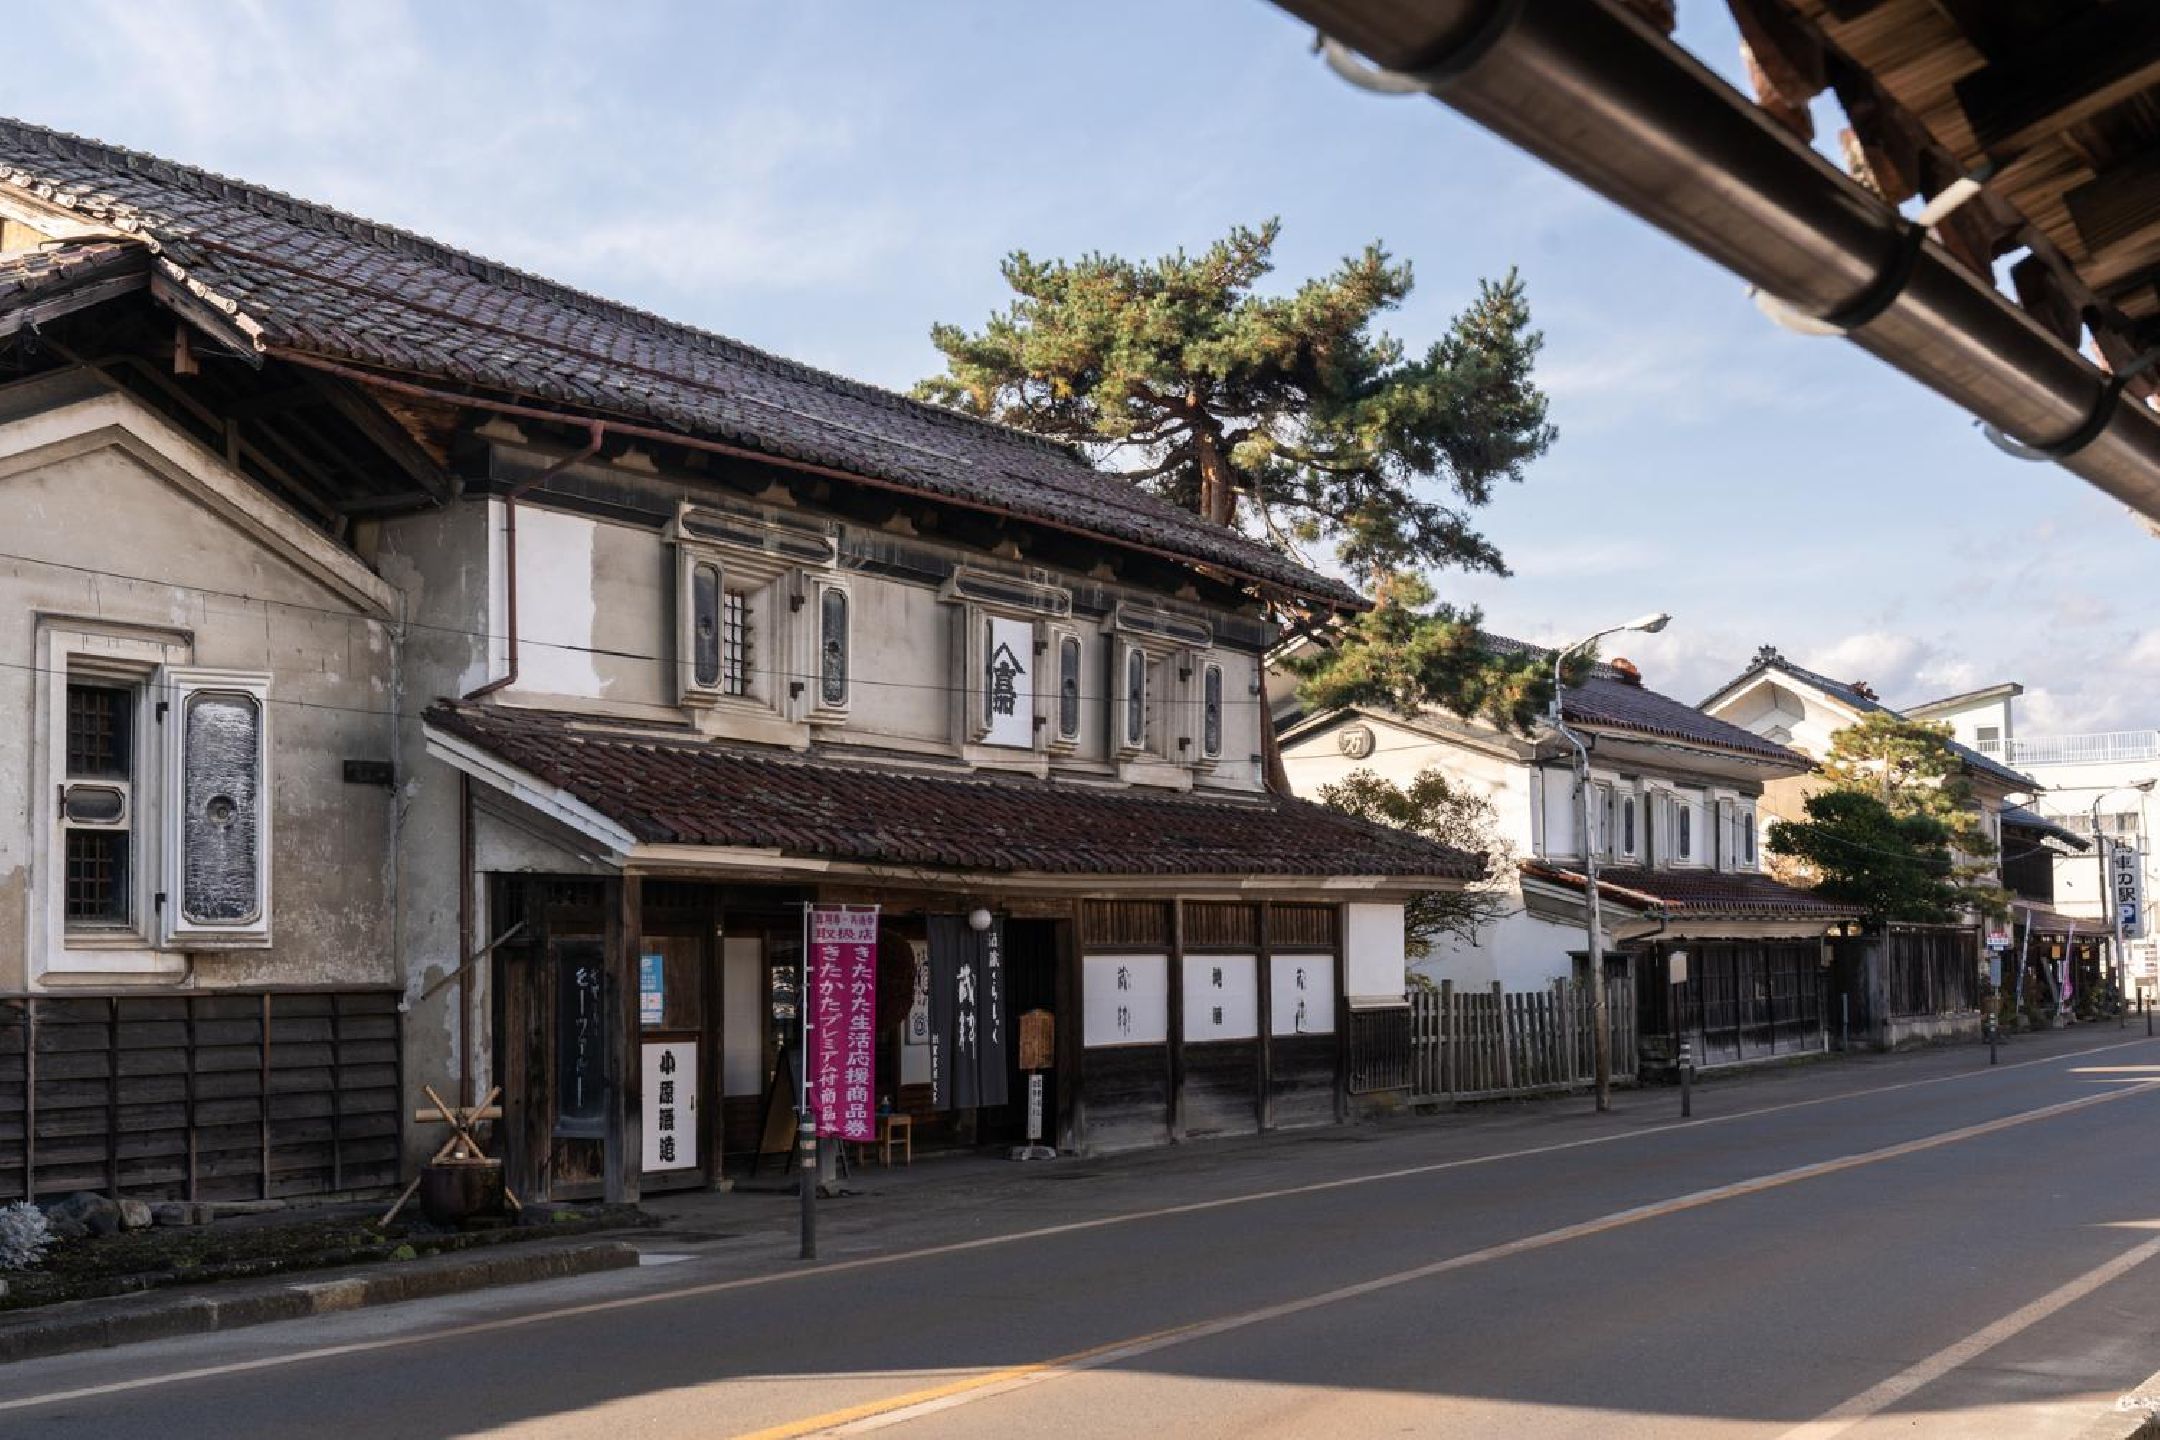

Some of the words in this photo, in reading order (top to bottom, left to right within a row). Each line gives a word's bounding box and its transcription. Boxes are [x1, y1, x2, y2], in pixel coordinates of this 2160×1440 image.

[659, 1050, 676, 1163] 小原酒造
[845, 945, 873, 1137] きたかた生活応援商品券
